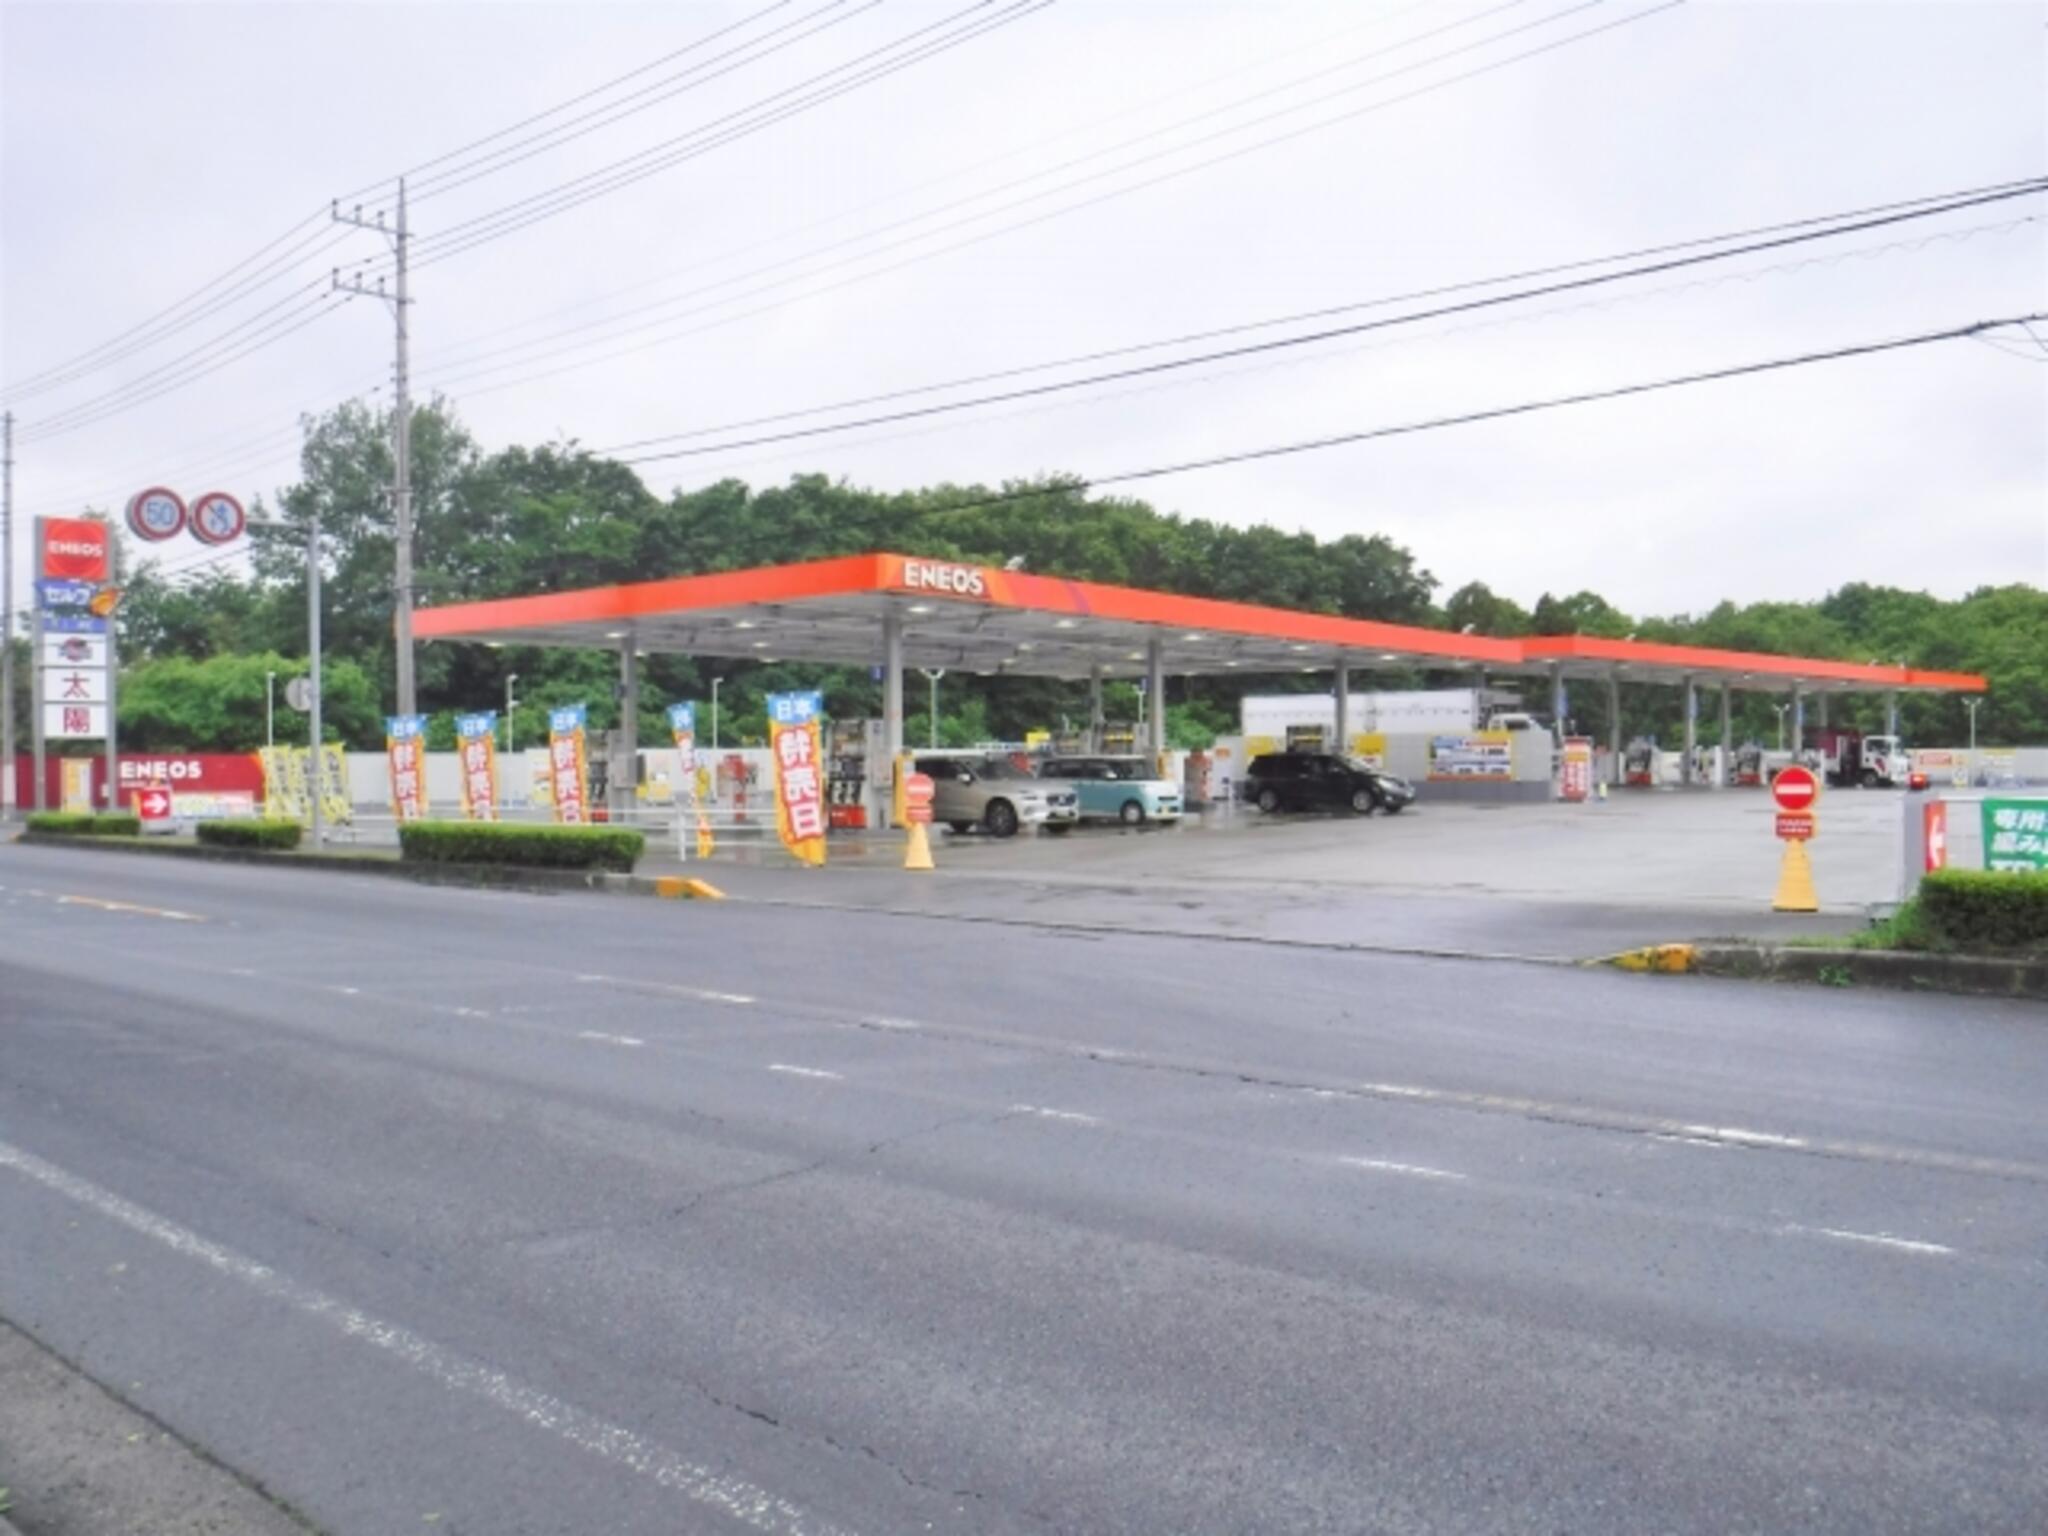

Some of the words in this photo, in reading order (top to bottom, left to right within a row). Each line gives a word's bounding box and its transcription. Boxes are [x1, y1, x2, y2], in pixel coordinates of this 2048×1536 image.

[146, 501, 177, 526] 50
[47, 540, 104, 557] ENEOS
[904, 561, 984, 596] ENEOS
[120, 761, 202, 779] ENEOS
